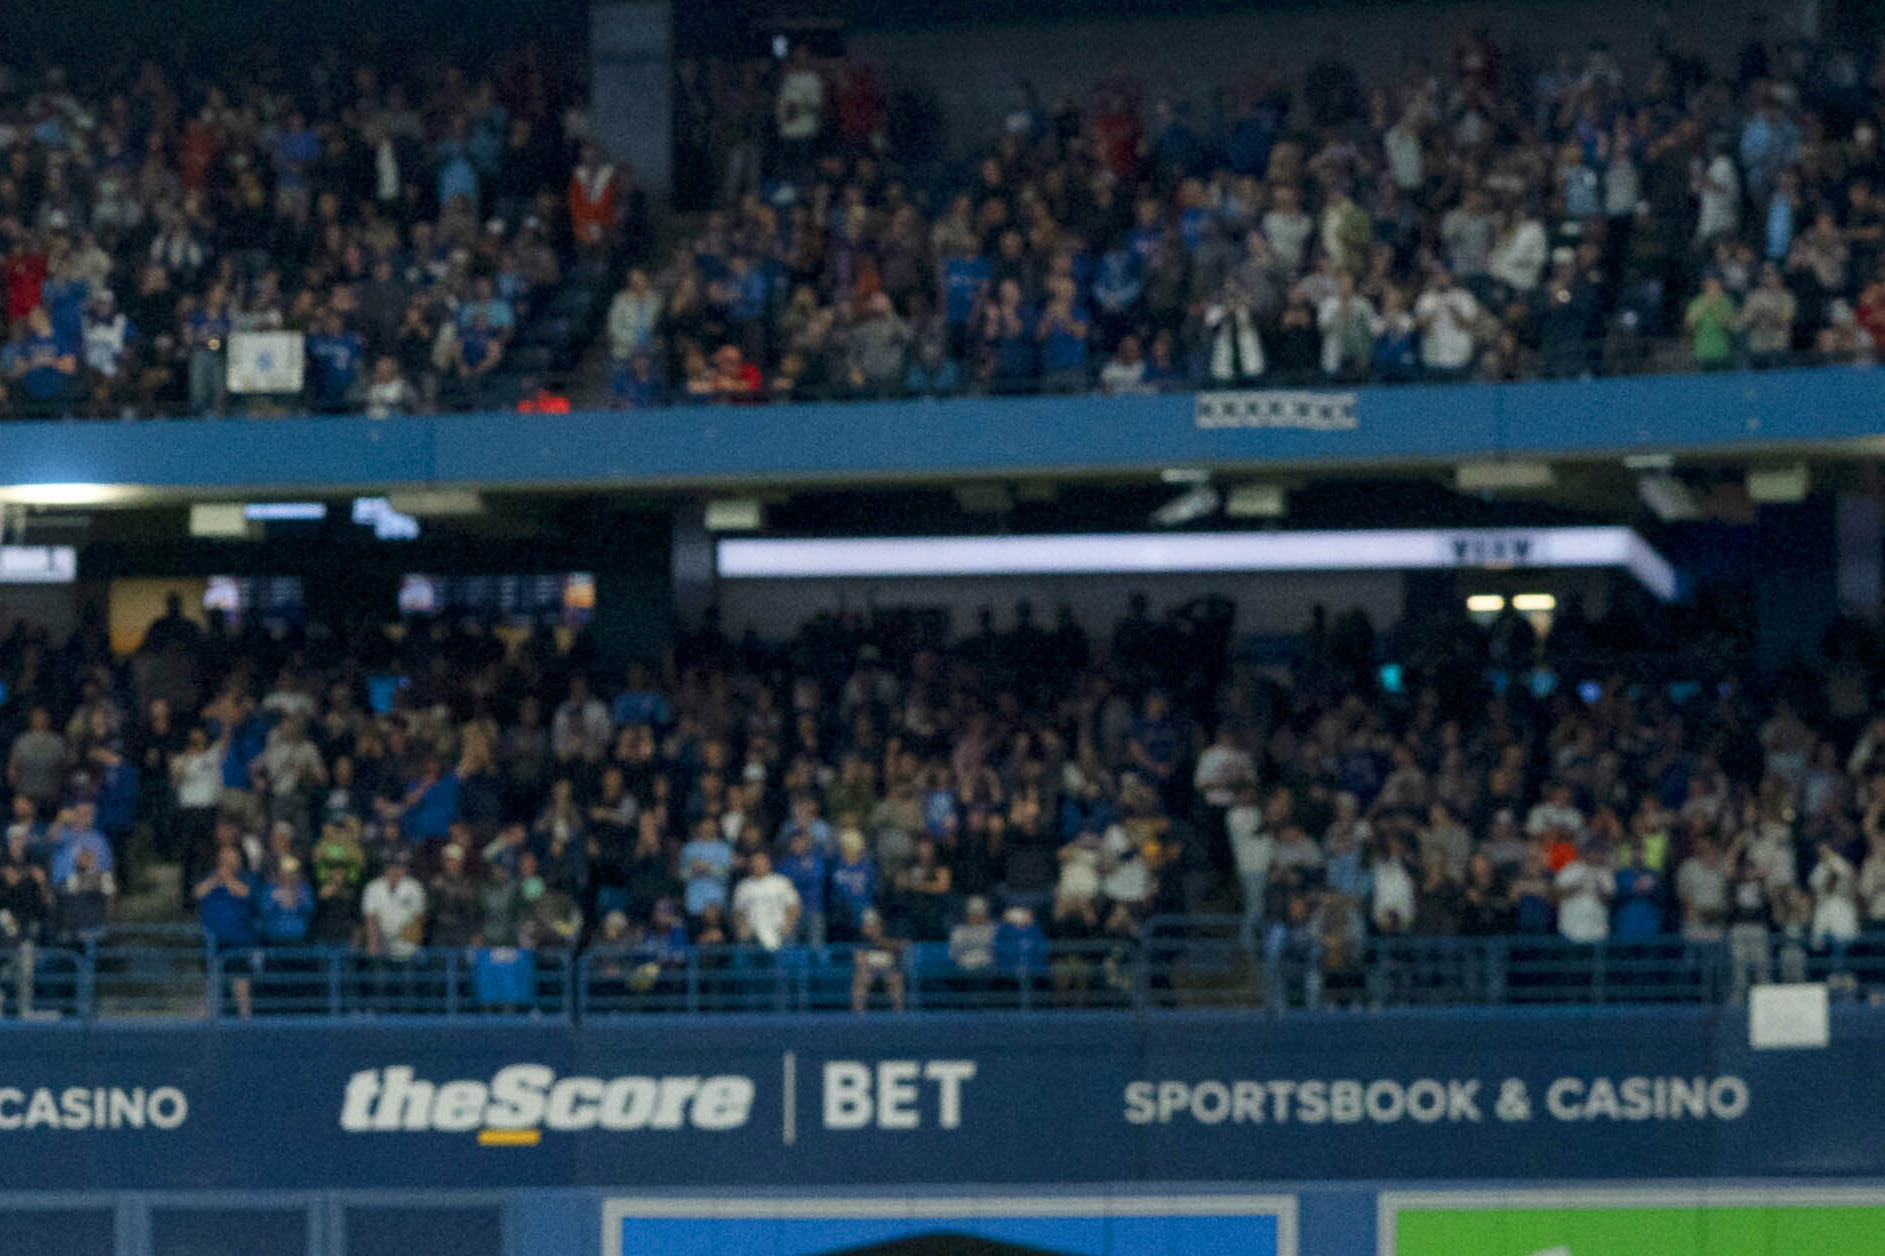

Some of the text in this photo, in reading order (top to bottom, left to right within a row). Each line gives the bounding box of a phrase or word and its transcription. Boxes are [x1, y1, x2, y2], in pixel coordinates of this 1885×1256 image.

[341, 1061, 976, 1131] theScore BET
[1124, 1075, 1750, 1124] SPORTSBOOK & CASINO
